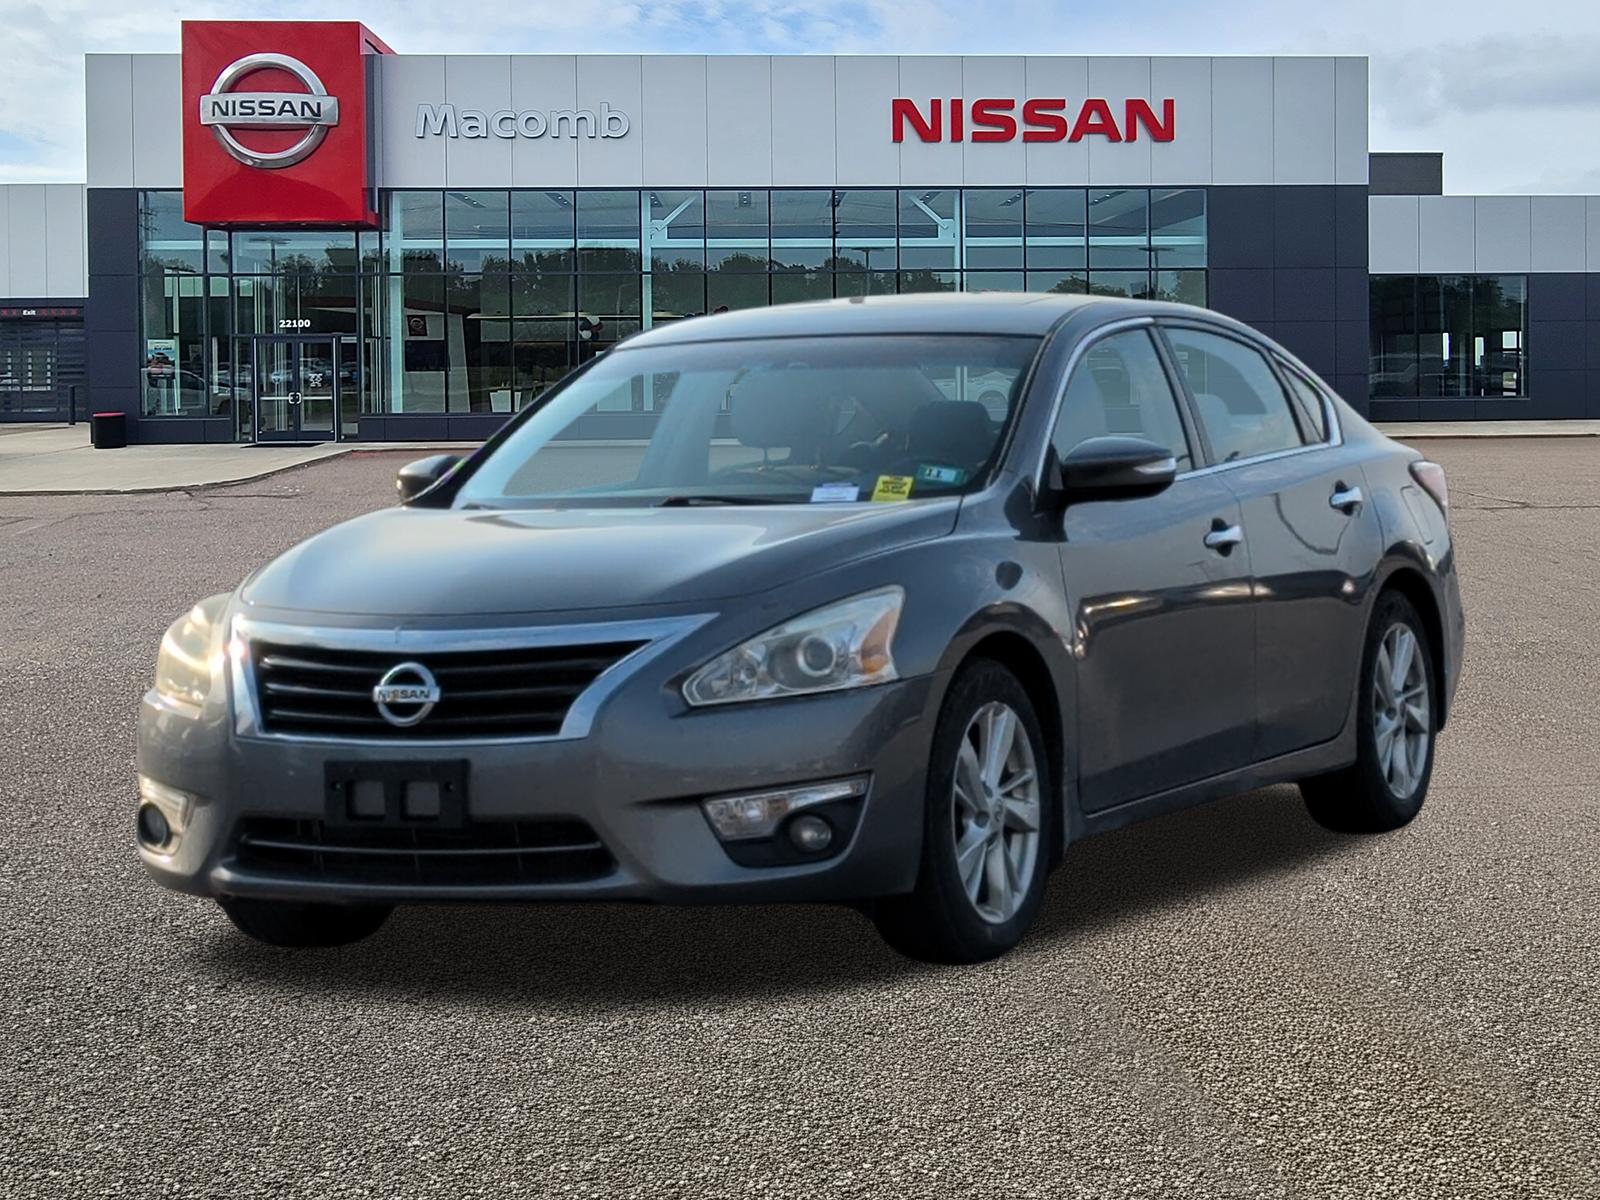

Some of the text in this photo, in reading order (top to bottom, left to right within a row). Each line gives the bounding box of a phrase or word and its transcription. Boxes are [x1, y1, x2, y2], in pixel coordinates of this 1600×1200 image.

[211, 100, 322, 118] NISSAN
[415, 102, 630, 139] Macomb
[892, 98, 1175, 143] NISSAN
[279, 319, 311, 328] 22100
[378, 688, 430, 700] NISSAN
